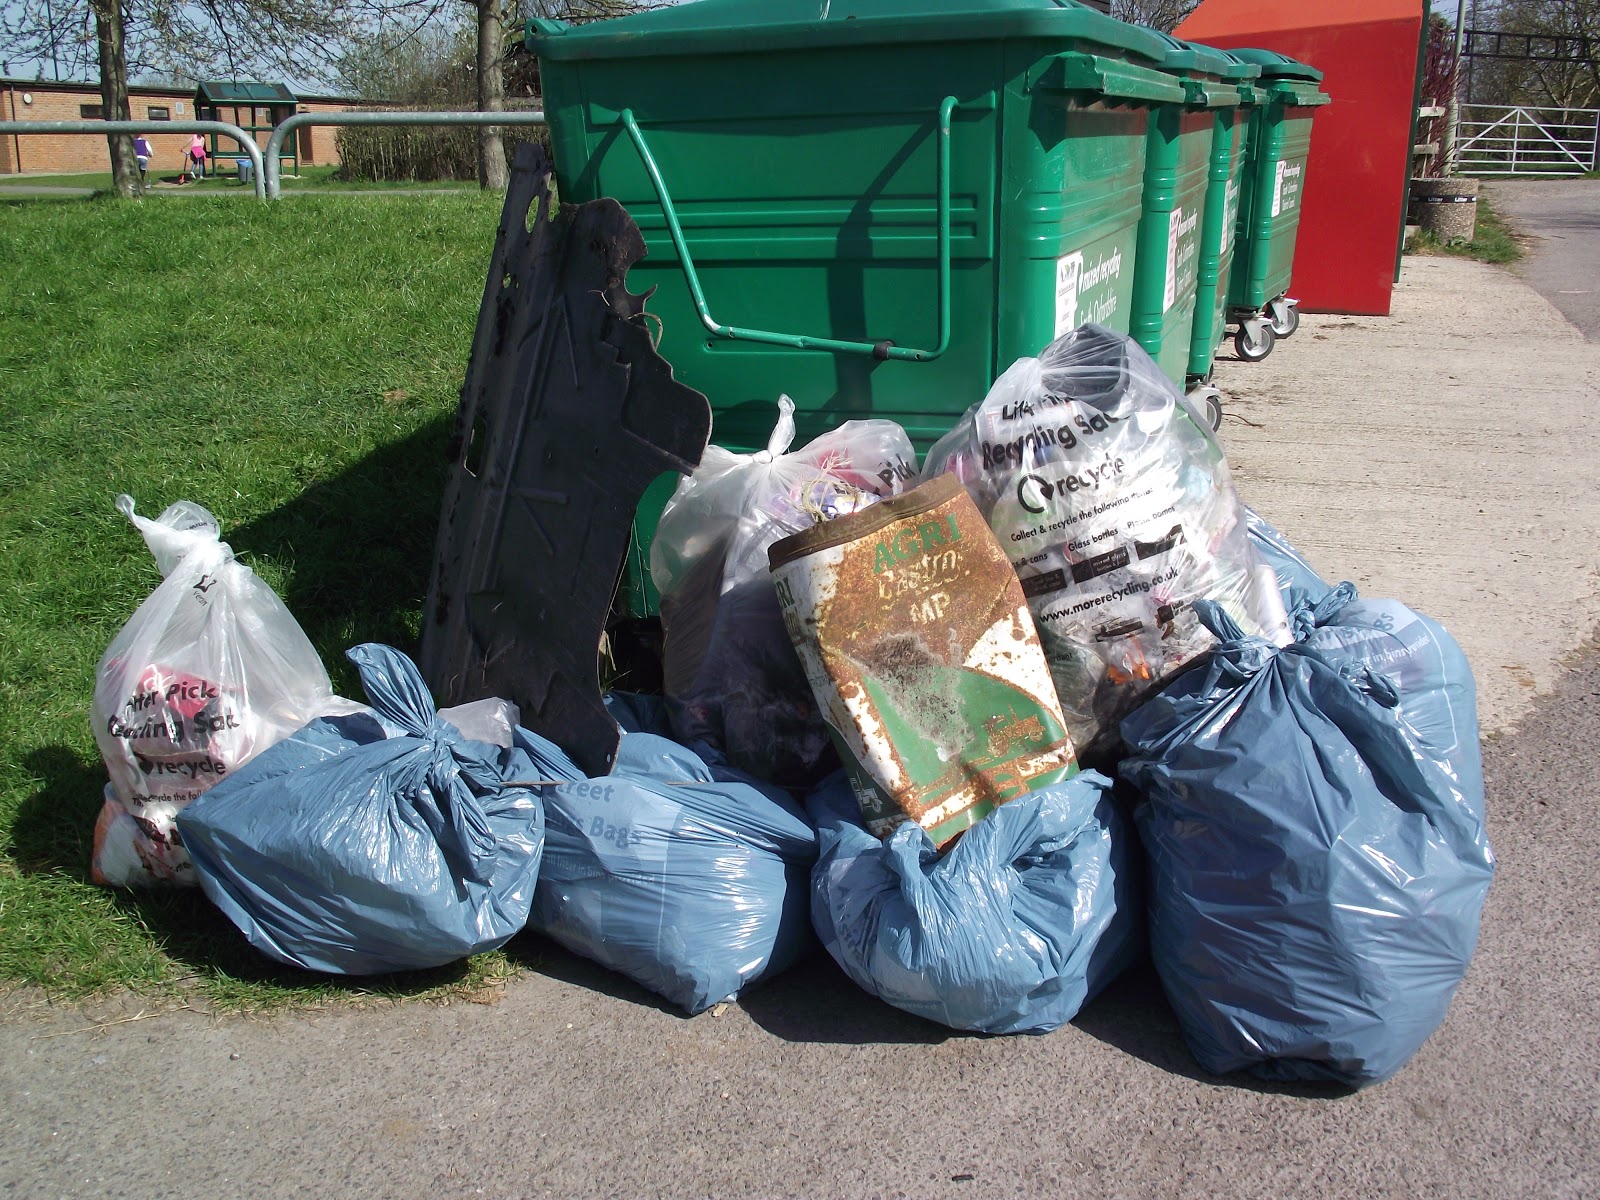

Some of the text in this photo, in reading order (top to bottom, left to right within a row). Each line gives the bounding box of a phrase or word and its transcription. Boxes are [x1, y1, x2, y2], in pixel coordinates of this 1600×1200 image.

[877, 453, 916, 489] Pick
[1056, 453, 1126, 496] recycle
[1011, 528, 1037, 542] Collect
[1040, 524, 1047, 533] &
[1049, 515, 1078, 531] recycle
[1079, 508, 1092, 520] the
[873, 512, 961, 574] AGRI
[1068, 527, 1119, 551] Glass bottles
[1021, 557, 1029, 567] &
[1029, 553, 1048, 564] cans
[1039, 566, 1179, 624] www.morerecycling.co.uk
[166, 680, 217, 702] Pick
[156, 755, 226, 779] recycle
[173, 791, 186, 801] the
[557, 781, 615, 802] treet
